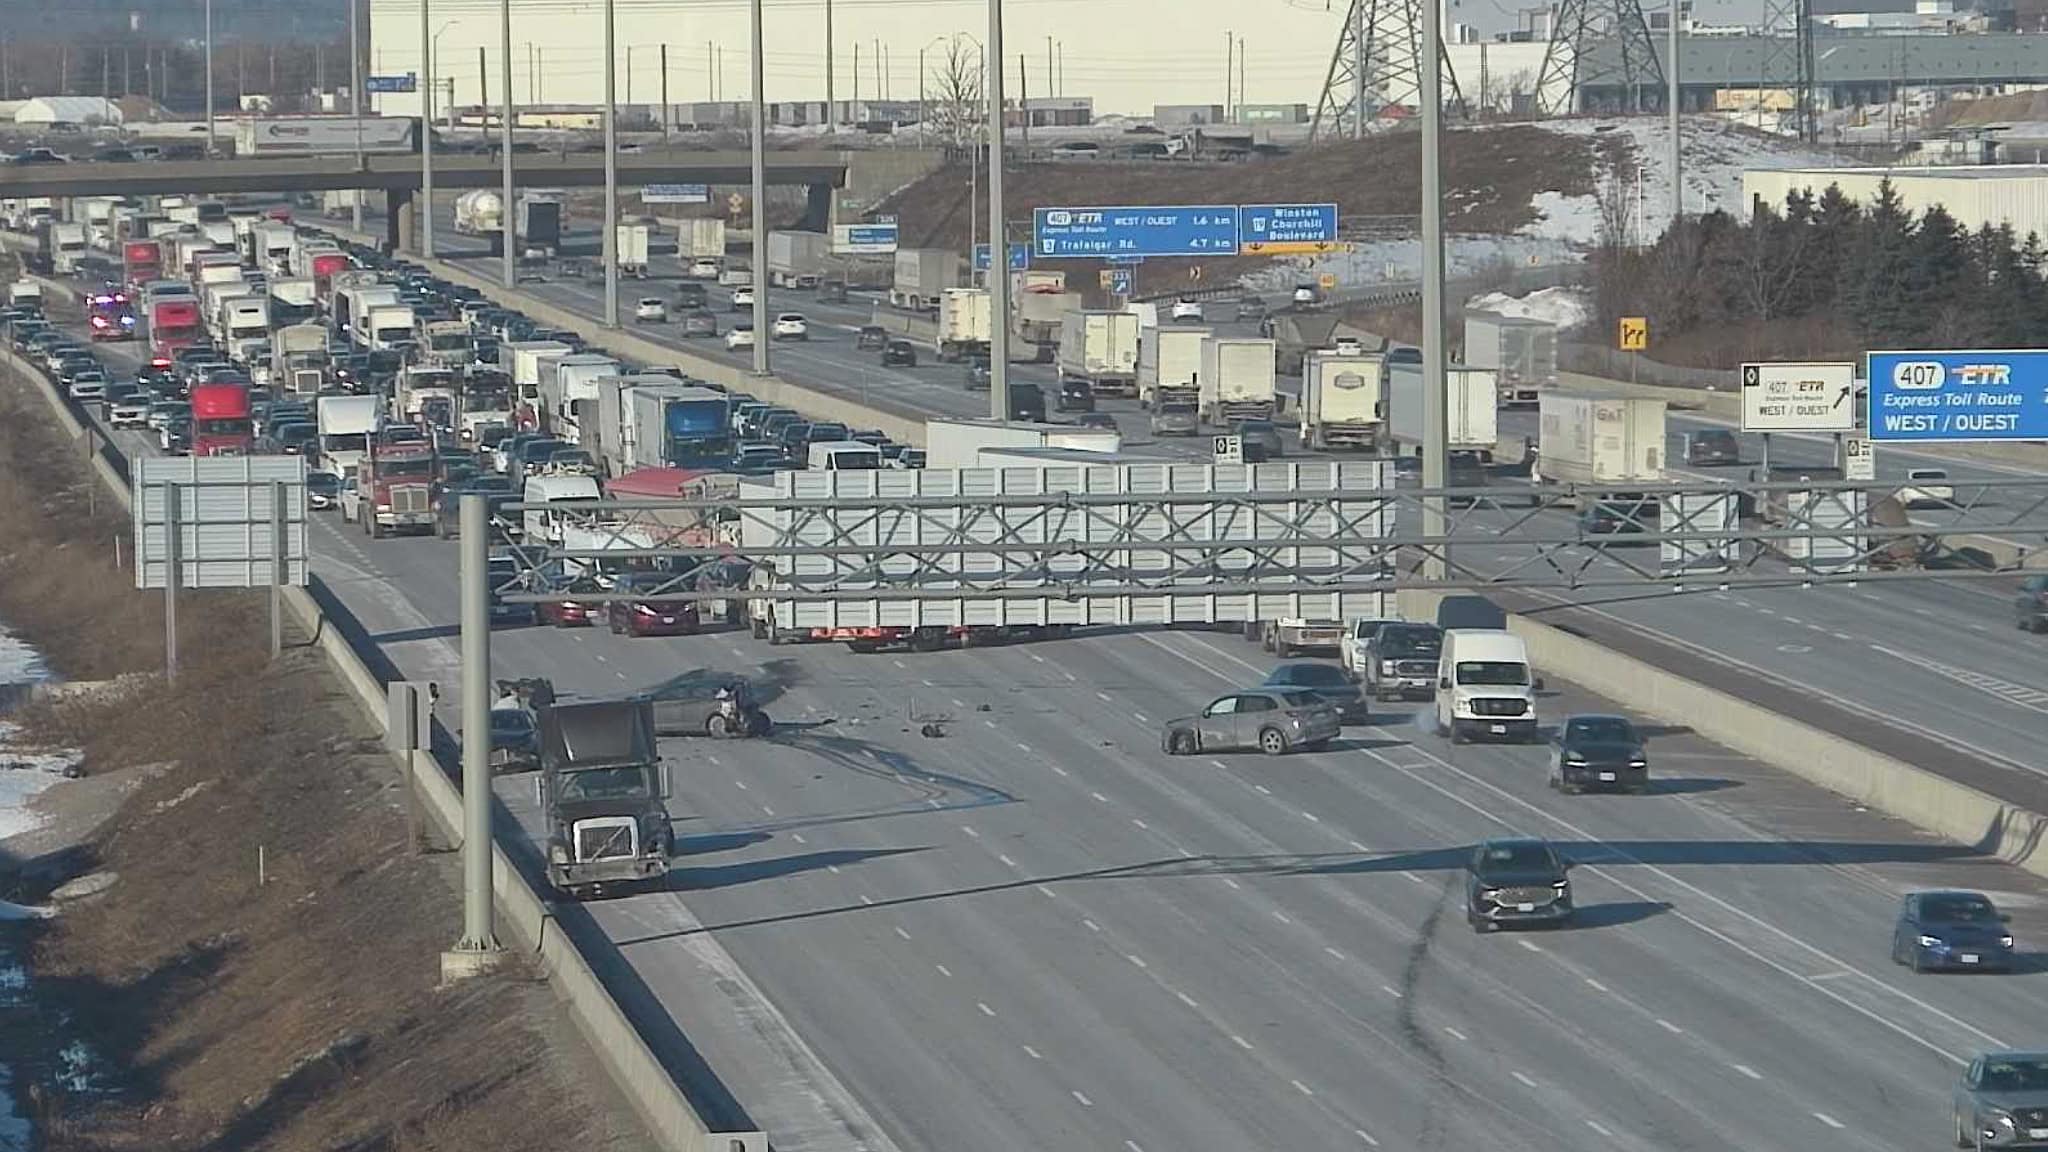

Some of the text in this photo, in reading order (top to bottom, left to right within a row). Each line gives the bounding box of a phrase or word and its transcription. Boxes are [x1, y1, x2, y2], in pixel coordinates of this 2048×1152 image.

[1274, 208, 1320, 218] Winston
[1114, 216, 1138, 226] WEST
[1147, 216, 1178, 226] OUEST
[1193, 216, 1209, 225] 1.6
[1214, 216, 1231, 225] km
[1271, 219, 1323, 229] Churchill
[1269, 231, 1325, 241] Boulevard
[1061, 240, 1113, 251] Trafalgar
[1119, 239, 1137, 249] Rd.
[1189, 238, 1208, 248] 4.7
[1214, 238, 1231, 248] km
[1900, 364, 2012, 385] 407 ETR
[1768, 381, 1825, 393] 407 ETR
[1884, 392, 2023, 409] Express Toll Route
[1759, 405, 1785, 416] WEST
[1796, 405, 1830, 416] OUEST
[1884, 414, 1938, 432] WEST
[1955, 414, 2020, 431] OUEST
